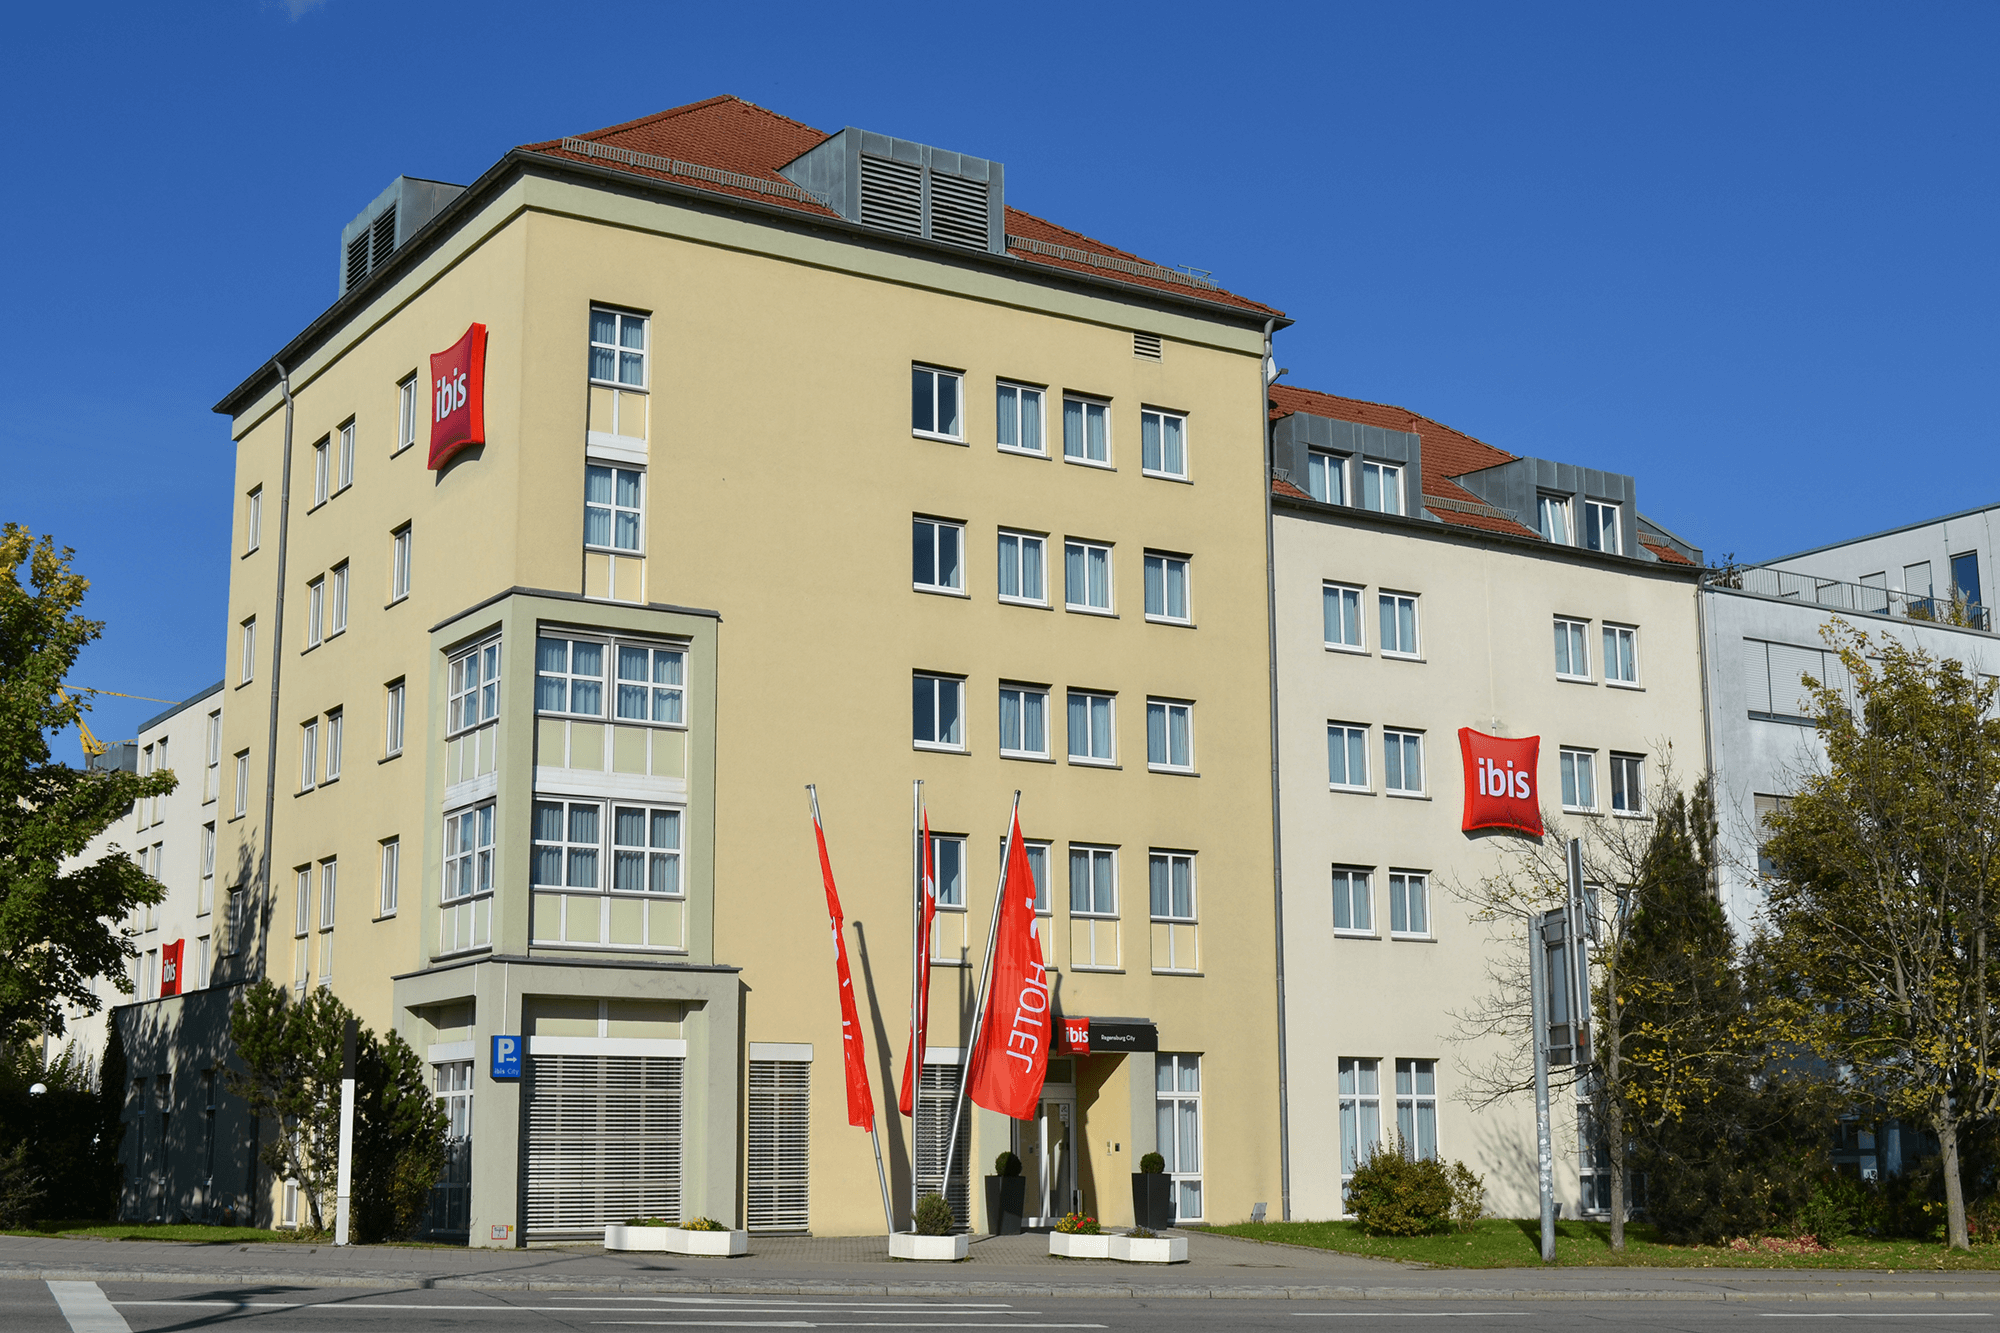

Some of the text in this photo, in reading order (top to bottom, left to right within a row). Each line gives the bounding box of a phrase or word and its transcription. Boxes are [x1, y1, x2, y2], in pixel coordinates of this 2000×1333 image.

[436, 367, 467, 423] ibis
[1478, 757, 1531, 800] ibis
[163, 958, 176, 983] ibis
[1065, 1026, 1089, 1043] ibis
[1101, 1034, 1136, 1042] Regensburg City
[497, 1038, 515, 1063] P
